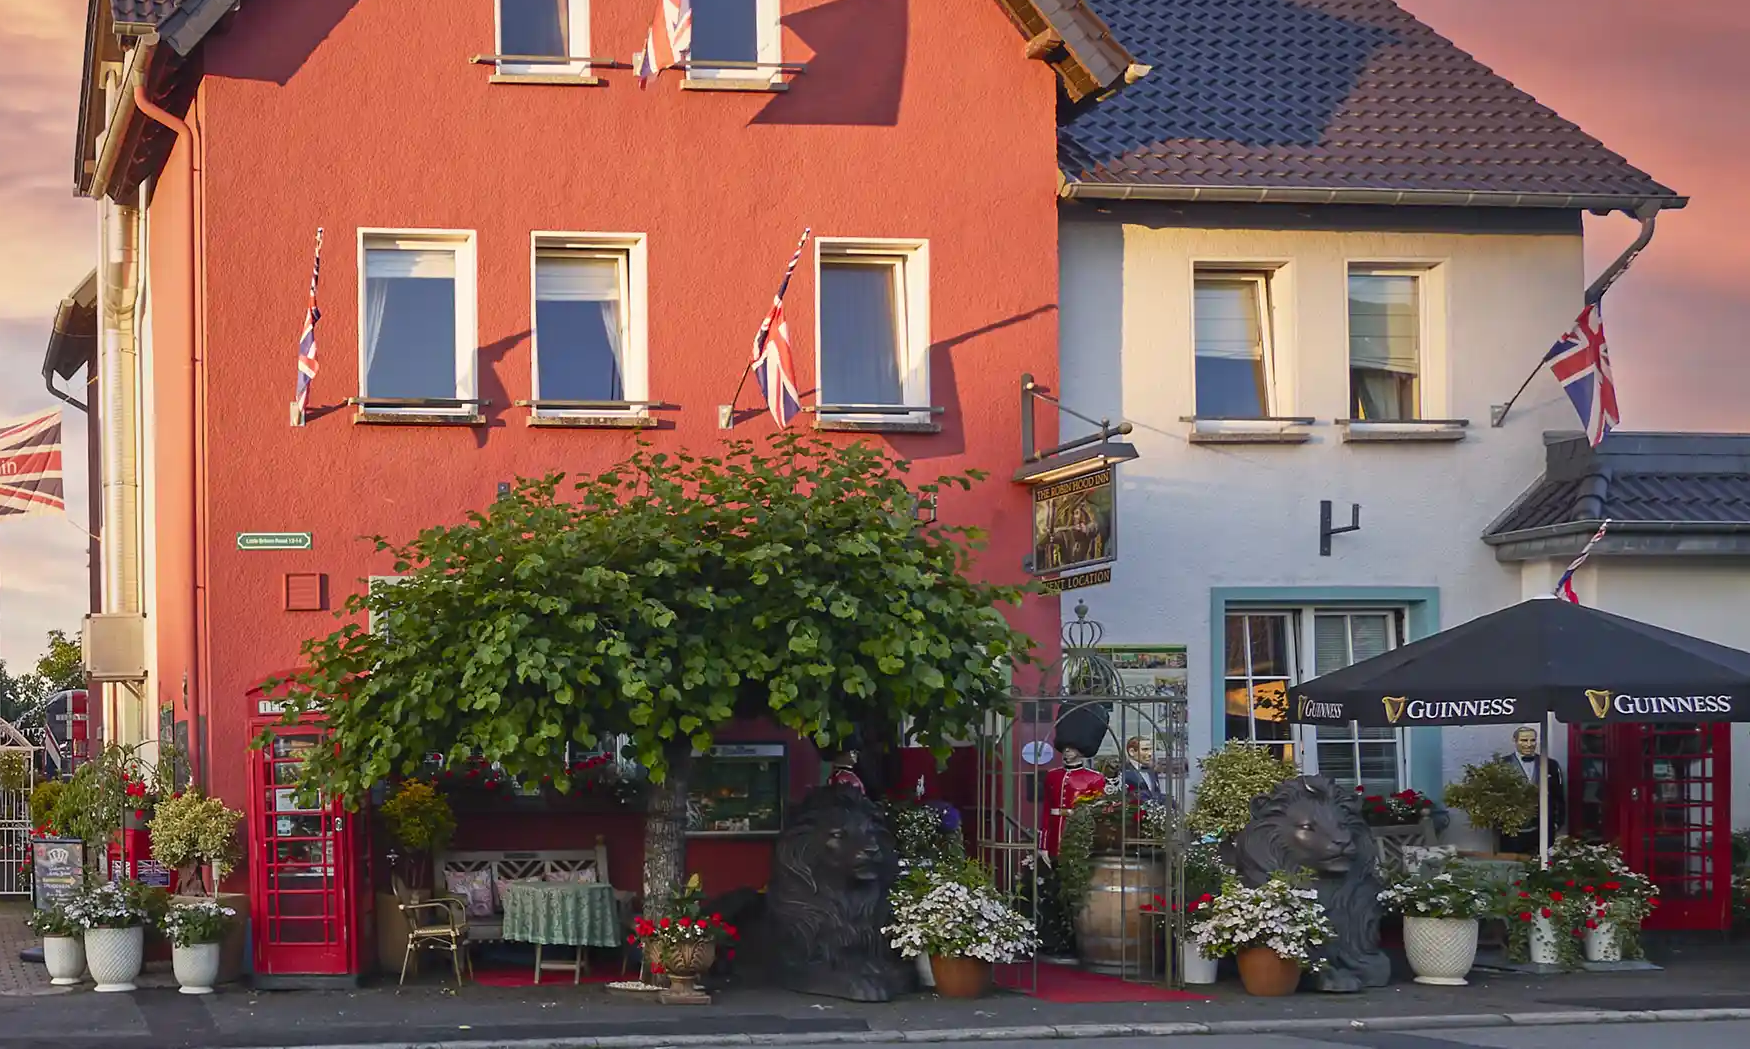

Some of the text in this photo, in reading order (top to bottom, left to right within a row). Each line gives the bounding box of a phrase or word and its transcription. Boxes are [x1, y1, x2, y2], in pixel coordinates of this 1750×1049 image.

[1036, 471, 1109, 501] THE ROBIN HOOD INN
[1068, 569, 1110, 588] LOCATION
[1305, 699, 1343, 719] GUINNESS
[1407, 698, 1515, 719] GUINNESS
[1614, 694, 1731, 714] GUINNESS
